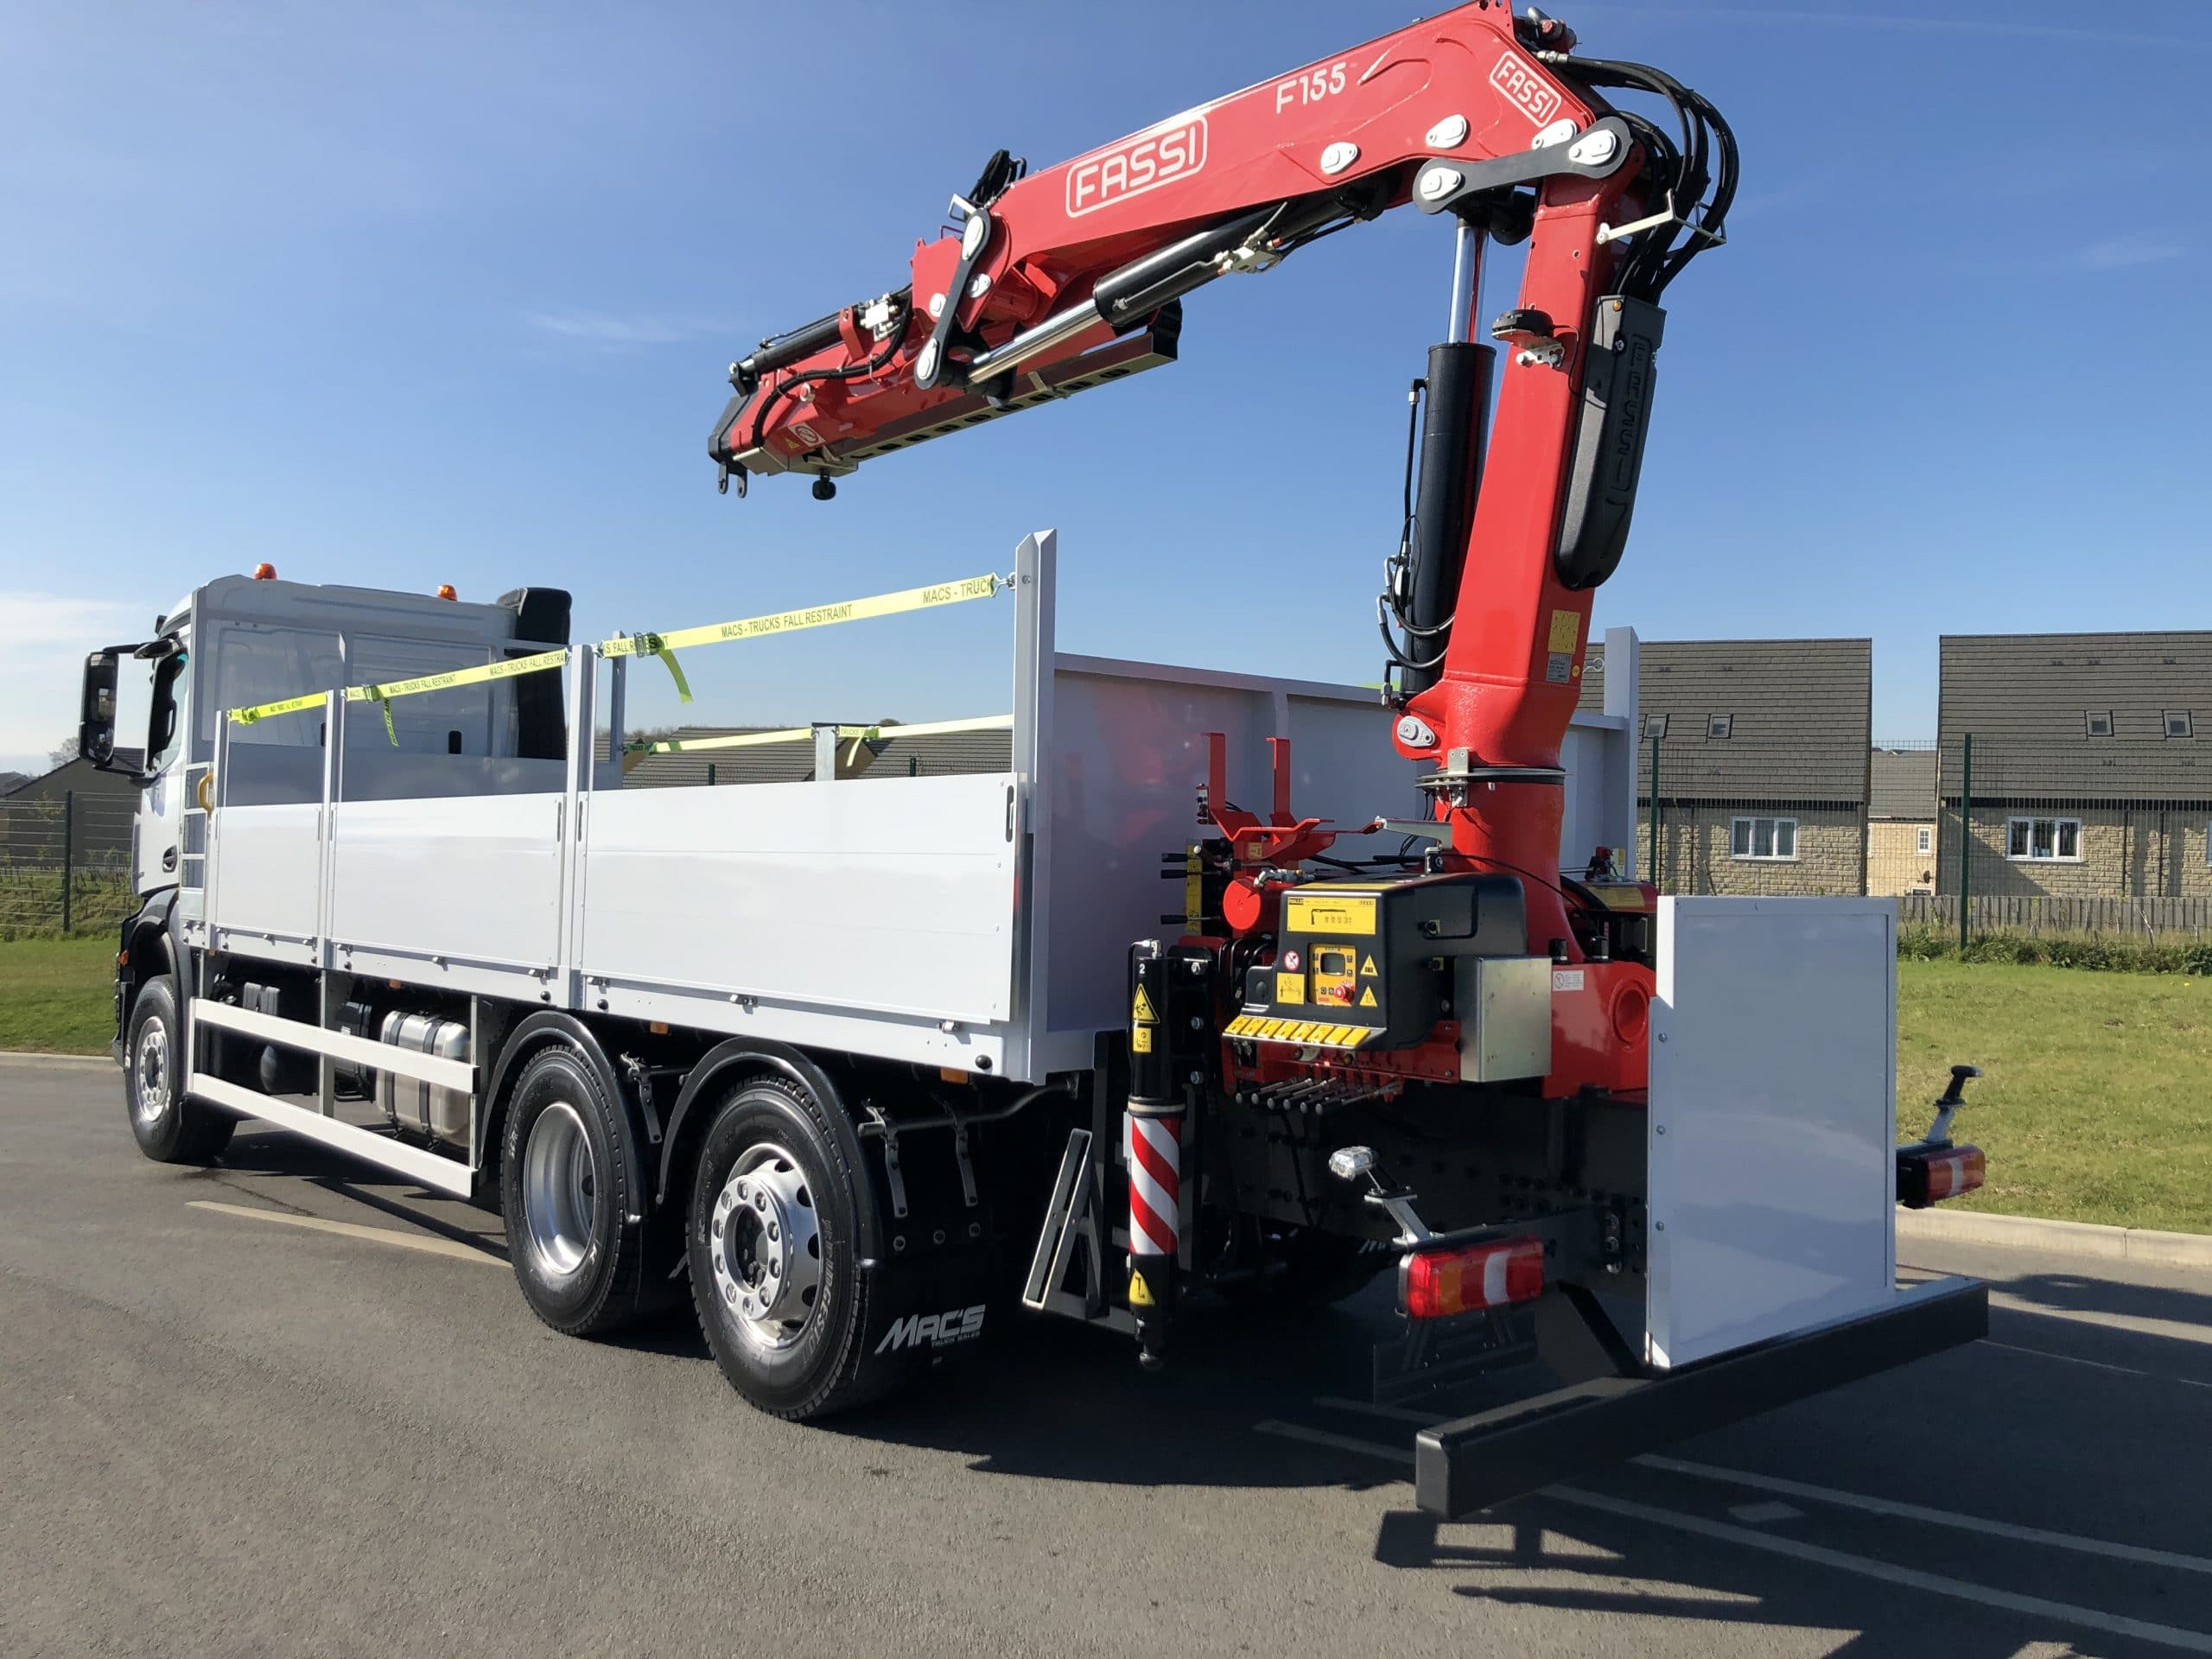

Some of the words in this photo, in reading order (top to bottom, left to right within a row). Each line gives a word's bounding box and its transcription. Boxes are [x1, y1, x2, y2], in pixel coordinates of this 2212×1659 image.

[1275, 62, 1346, 114] F155
[1497, 58, 1554, 118] FASSI
[1076, 125, 1196, 207] FASSI
[923, 587, 951, 604] MACS
[721, 624, 742, 638] MACS
[748, 616, 780, 633] TRUCKS
[784, 613, 804, 628] FALL
[805, 604, 852, 624] RESTRAINT
[1139, 963, 1146, 975] 2
